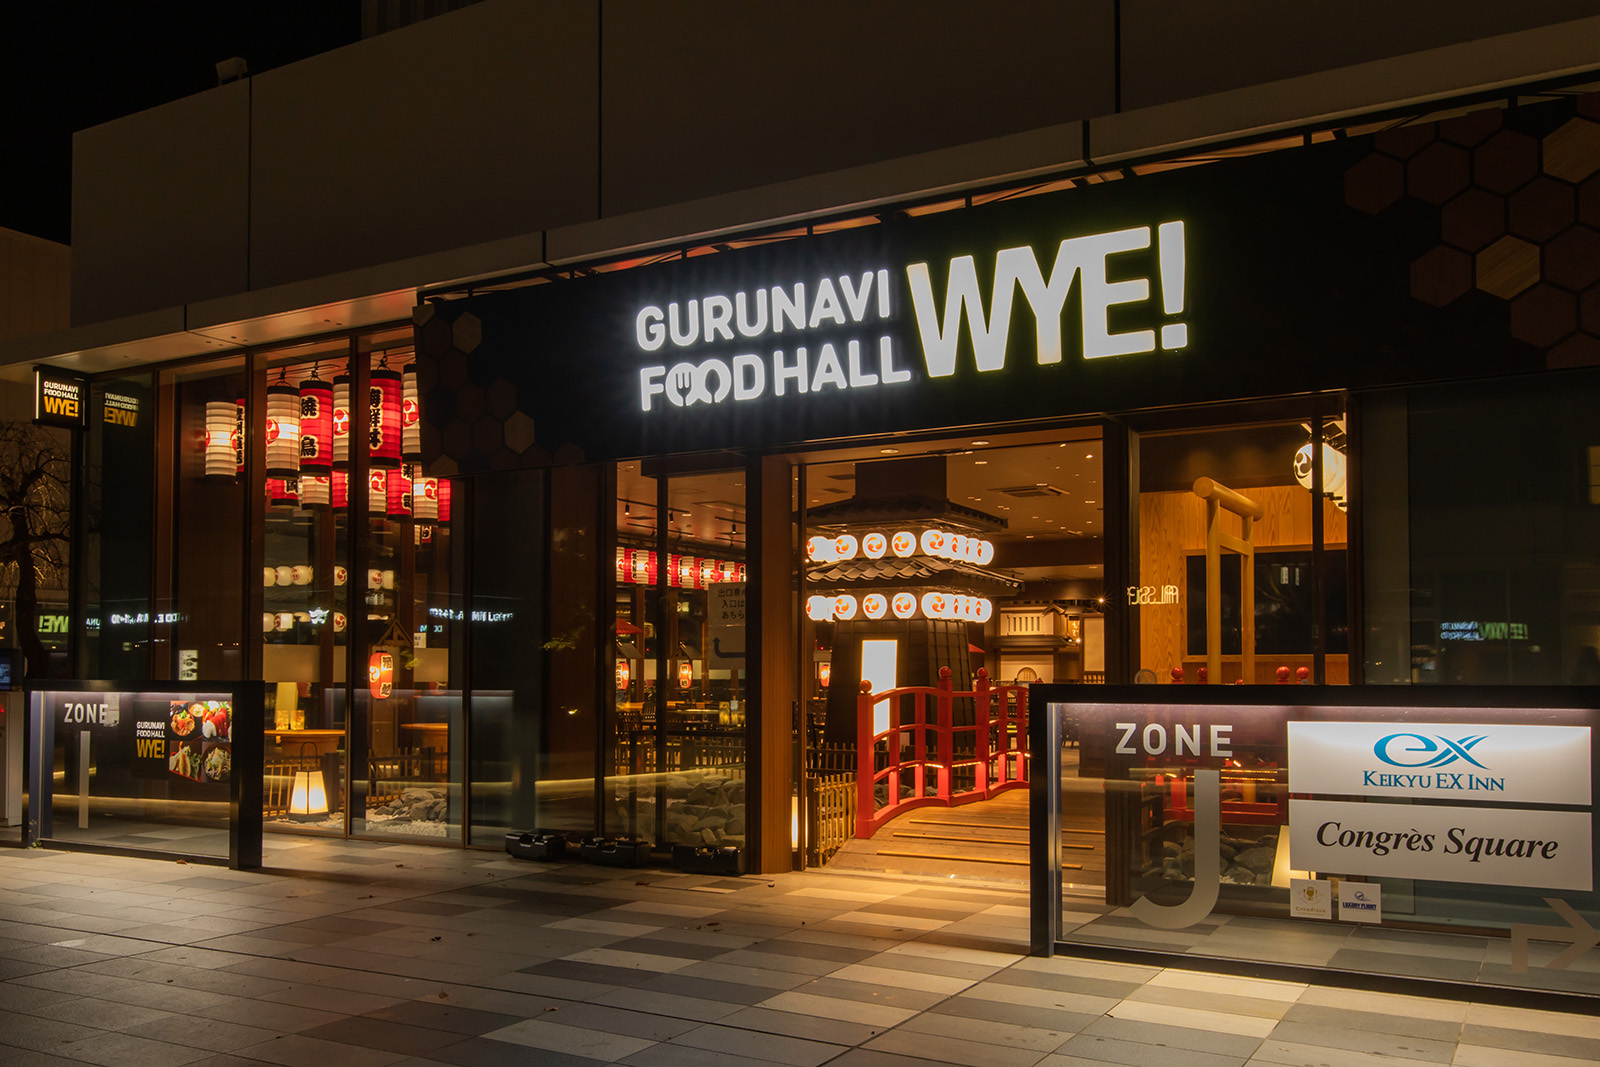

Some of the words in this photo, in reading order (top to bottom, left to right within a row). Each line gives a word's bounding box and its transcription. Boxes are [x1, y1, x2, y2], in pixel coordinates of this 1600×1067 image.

[636, 268, 891, 352] GURUNAVI
[906, 220, 1188, 379] WYE!
[43, 380, 79, 394] GURUNAVI
[43, 396, 79, 418] WYE!
[721, 599, 745, 608] 入口は
[721, 610, 745, 620] あちら
[63, 702, 109, 724] ZONE
[136, 721, 165, 730] GURUNAVI
[136, 739, 165, 759] WYE!
[1115, 722, 1233, 758] ZONE
[1362, 770, 1431, 789] KEIKYU
[1435, 772, 1464, 790] EX
[1467, 773, 1506, 792] INN
[1128, 769, 1220, 929] J
[1316, 821, 1436, 857] Congrès
[1444, 827, 1559, 862] Square
